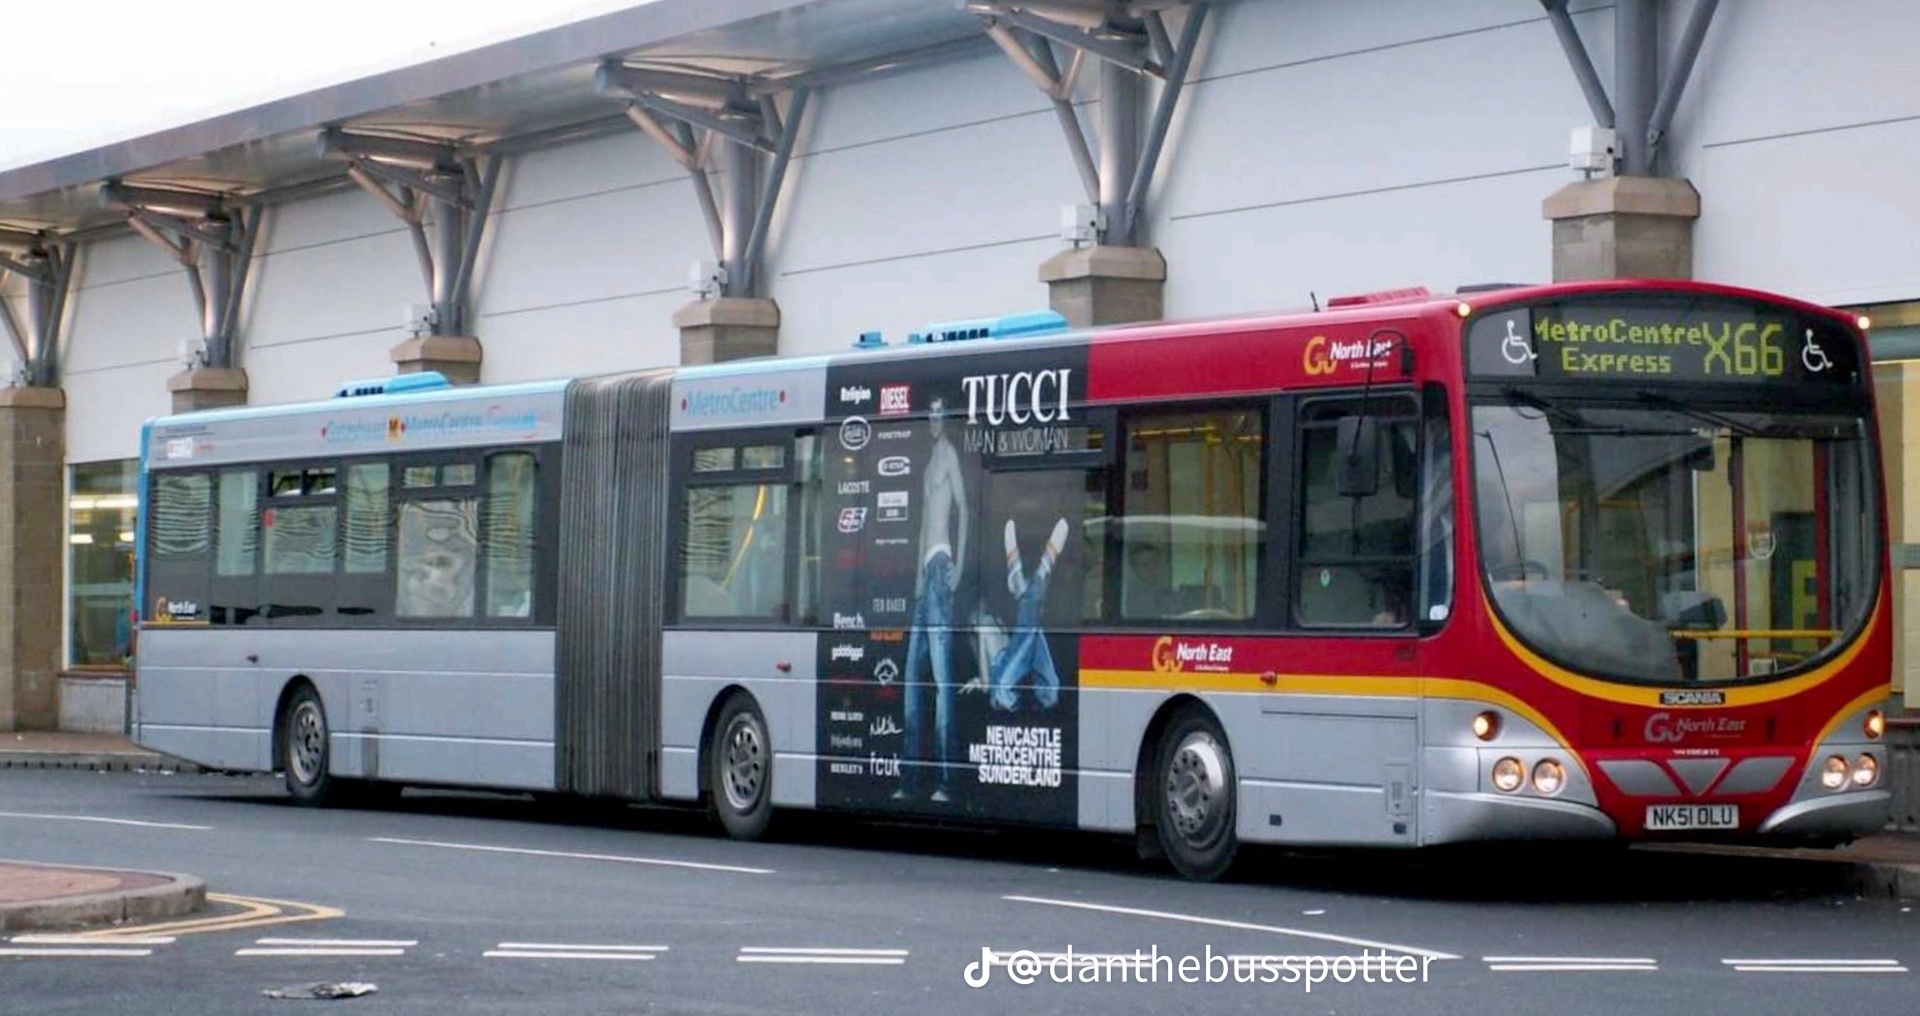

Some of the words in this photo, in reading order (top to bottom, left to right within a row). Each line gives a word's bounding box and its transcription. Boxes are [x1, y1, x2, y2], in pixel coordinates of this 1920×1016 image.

[1535, 318, 1701, 345] MetroCentre
[1330, 341, 1364, 359] North
[1703, 323, 1783, 375] X66
[1561, 347, 1671, 374] Express
[881, 387, 909, 409] DIESEL
[962, 369, 1071, 425] TUCCI
[964, 429, 995, 454] MAN
[999, 431, 1008, 452] &
[1012, 426, 1068, 451] WOMAN
[838, 480, 869, 495] LACOSTE
[1176, 643, 1208, 661] North
[1209, 643, 1232, 662] East
[1664, 692, 1721, 704] SCANIA
[1676, 718, 1714, 733] North
[1717, 717, 1746, 732] East
[986, 726, 1061, 747] NEWCASTLE
[969, 744, 1061, 767] METROCENTRE
[979, 765, 1061, 787] SUNDERLAND
[1653, 807, 1693, 826] NK51
[1698, 807, 1732, 826] OLU
